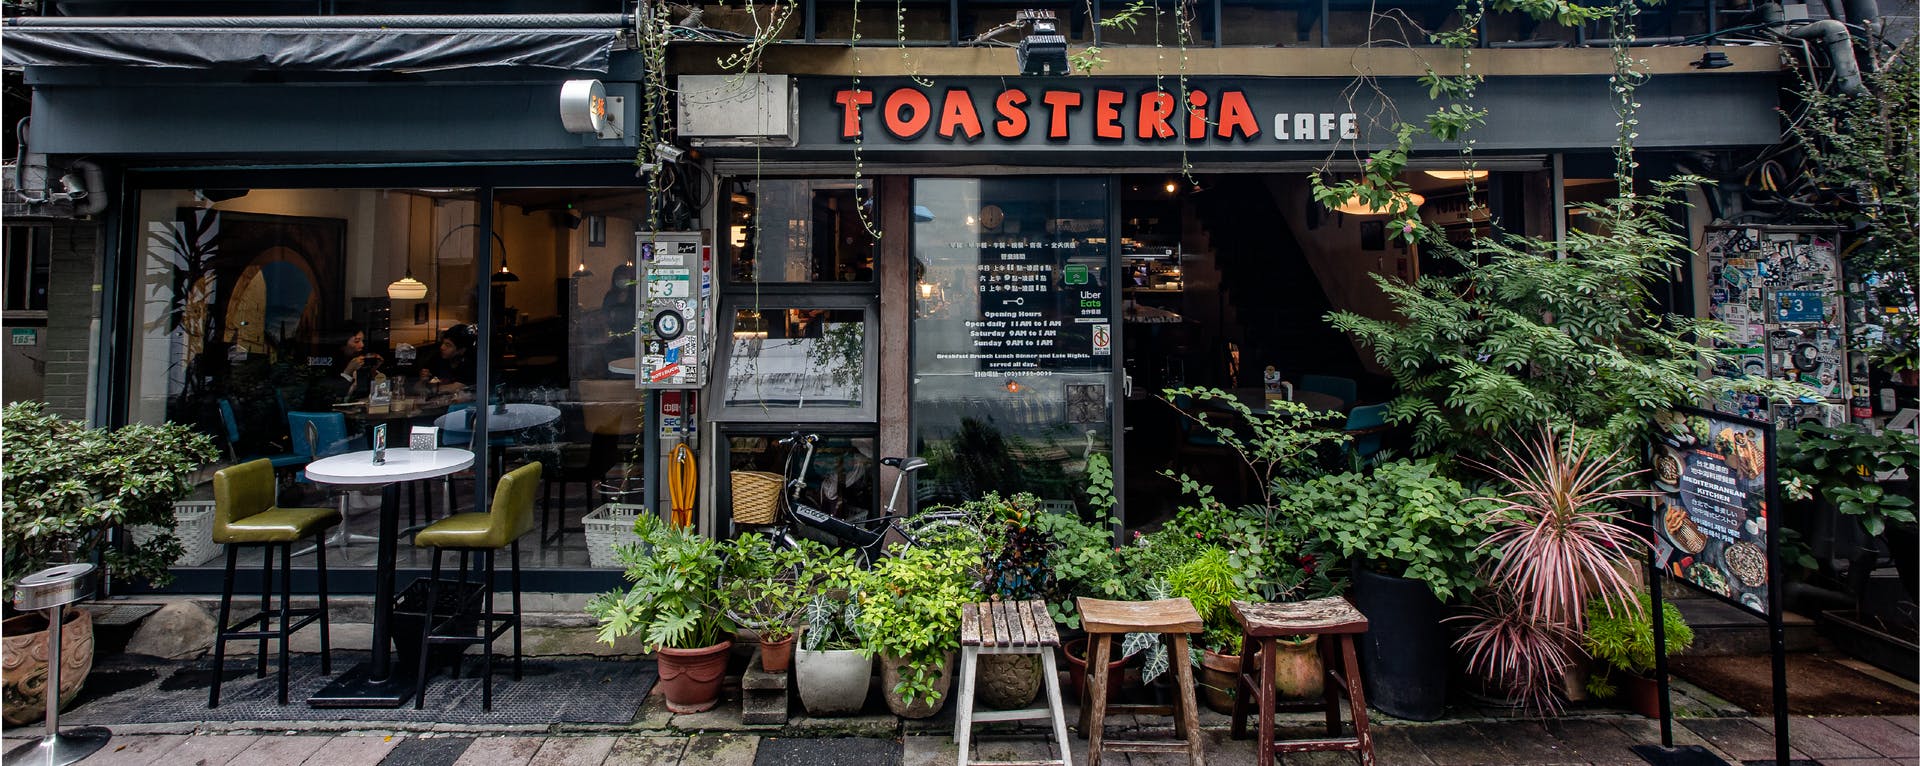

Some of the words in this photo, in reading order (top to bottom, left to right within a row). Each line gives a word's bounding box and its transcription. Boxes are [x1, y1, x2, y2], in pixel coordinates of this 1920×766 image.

[1274, 113, 1357, 140] CAFE
[663, 282, 674, 297] 3
[1080, 290, 1102, 299] Uber
[1080, 299, 1102, 308] Eats
[1793, 299, 1804, 312] 3
[664, 417, 694, 426] SECM
[1682, 475, 1746, 499] MEDITERRANEAN
[1697, 487, 1730, 502] KITCHEN
